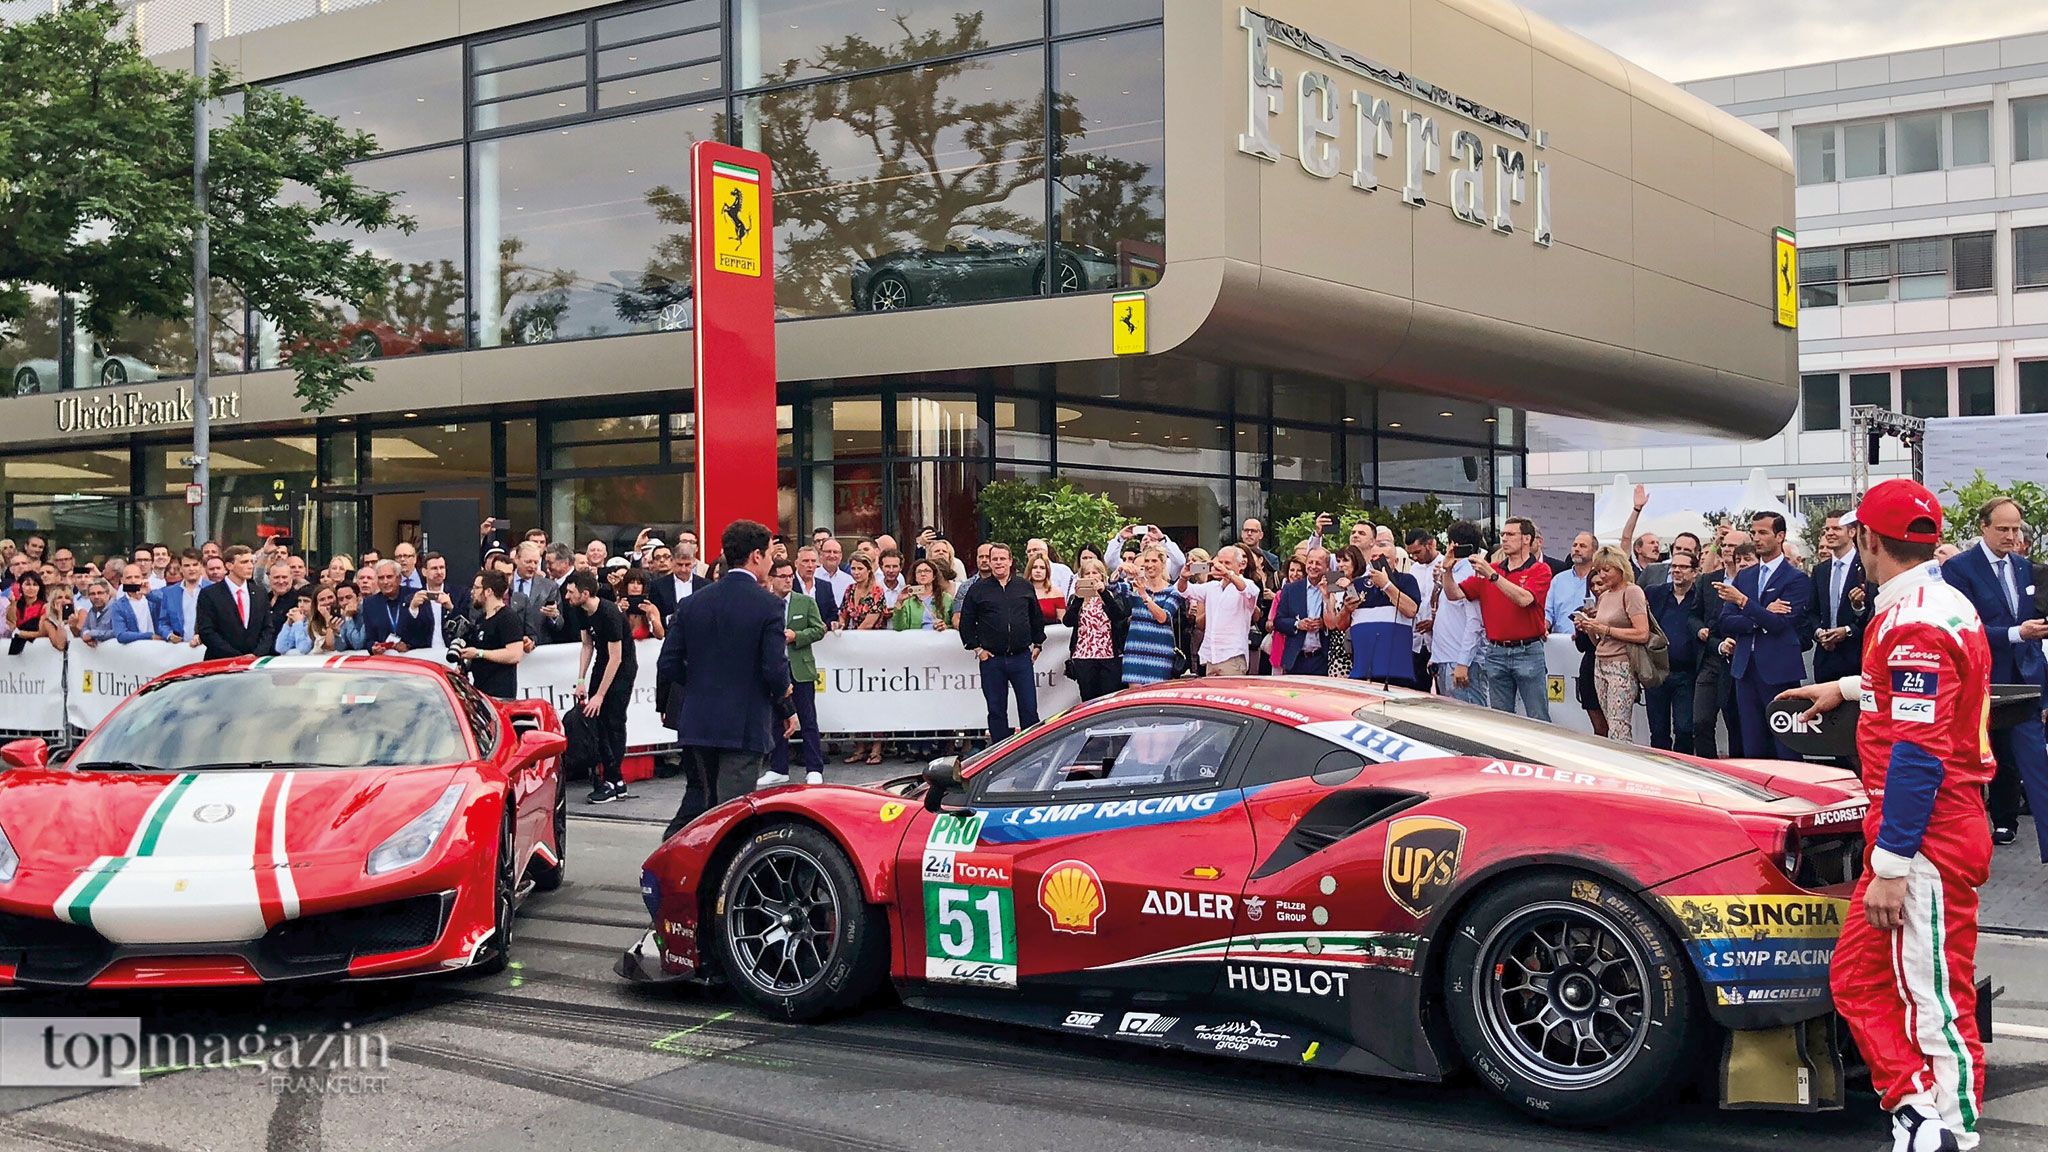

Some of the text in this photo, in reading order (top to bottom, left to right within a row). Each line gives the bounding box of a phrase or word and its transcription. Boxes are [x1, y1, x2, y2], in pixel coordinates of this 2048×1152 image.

[1238, 6, 1554, 248] Ferrari
[719, 254, 757, 271] Ferrari
[54, 386, 240, 433] UlrichFrankurt
[1861, 693, 1873, 703] EC
[1899, 702, 1932, 713] WEC
[1273, 706, 1310, 724] SERRA
[1341, 723, 1416, 762] IHI
[1480, 761, 1598, 787] ADLER
[1024, 792, 1219, 825] SMP RACING
[930, 813, 982, 846] PRO
[924, 855, 1010, 880] 24h TOTAL
[1141, 889, 1235, 920] ADLER
[1726, 902, 1840, 927] SINGHA
[938, 887, 1004, 961] 51
[1721, 950, 1771, 968] SMP
[951, 963, 1007, 981] WEC
[1227, 964, 1350, 997] HUBLOT
[1748, 987, 1822, 1000] MICHELIN
[1065, 1014, 1101, 1026] OMP
[1196, 1031, 1279, 1048] nordmeccanica
[1215, 1040, 1250, 1052] group
[1798, 1076, 1808, 1084] 51
